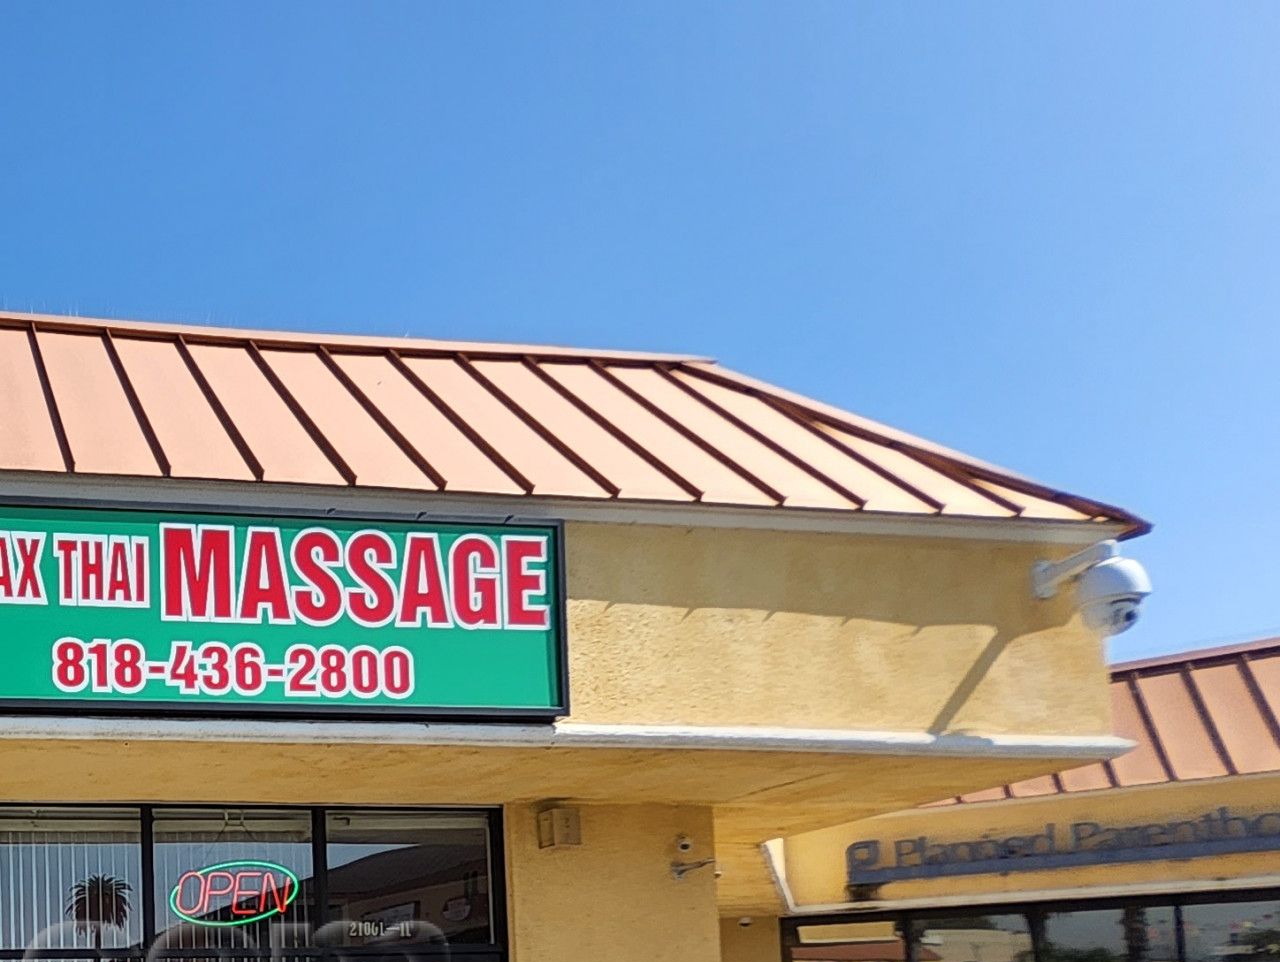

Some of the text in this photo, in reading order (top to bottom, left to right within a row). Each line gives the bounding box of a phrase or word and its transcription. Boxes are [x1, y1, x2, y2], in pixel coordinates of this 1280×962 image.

[55, 533, 149, 606] THAI
[160, 524, 550, 629] MASSAGE
[54, 640, 414, 697] 818-436-2800
[176, 872, 291, 914] OPEN
